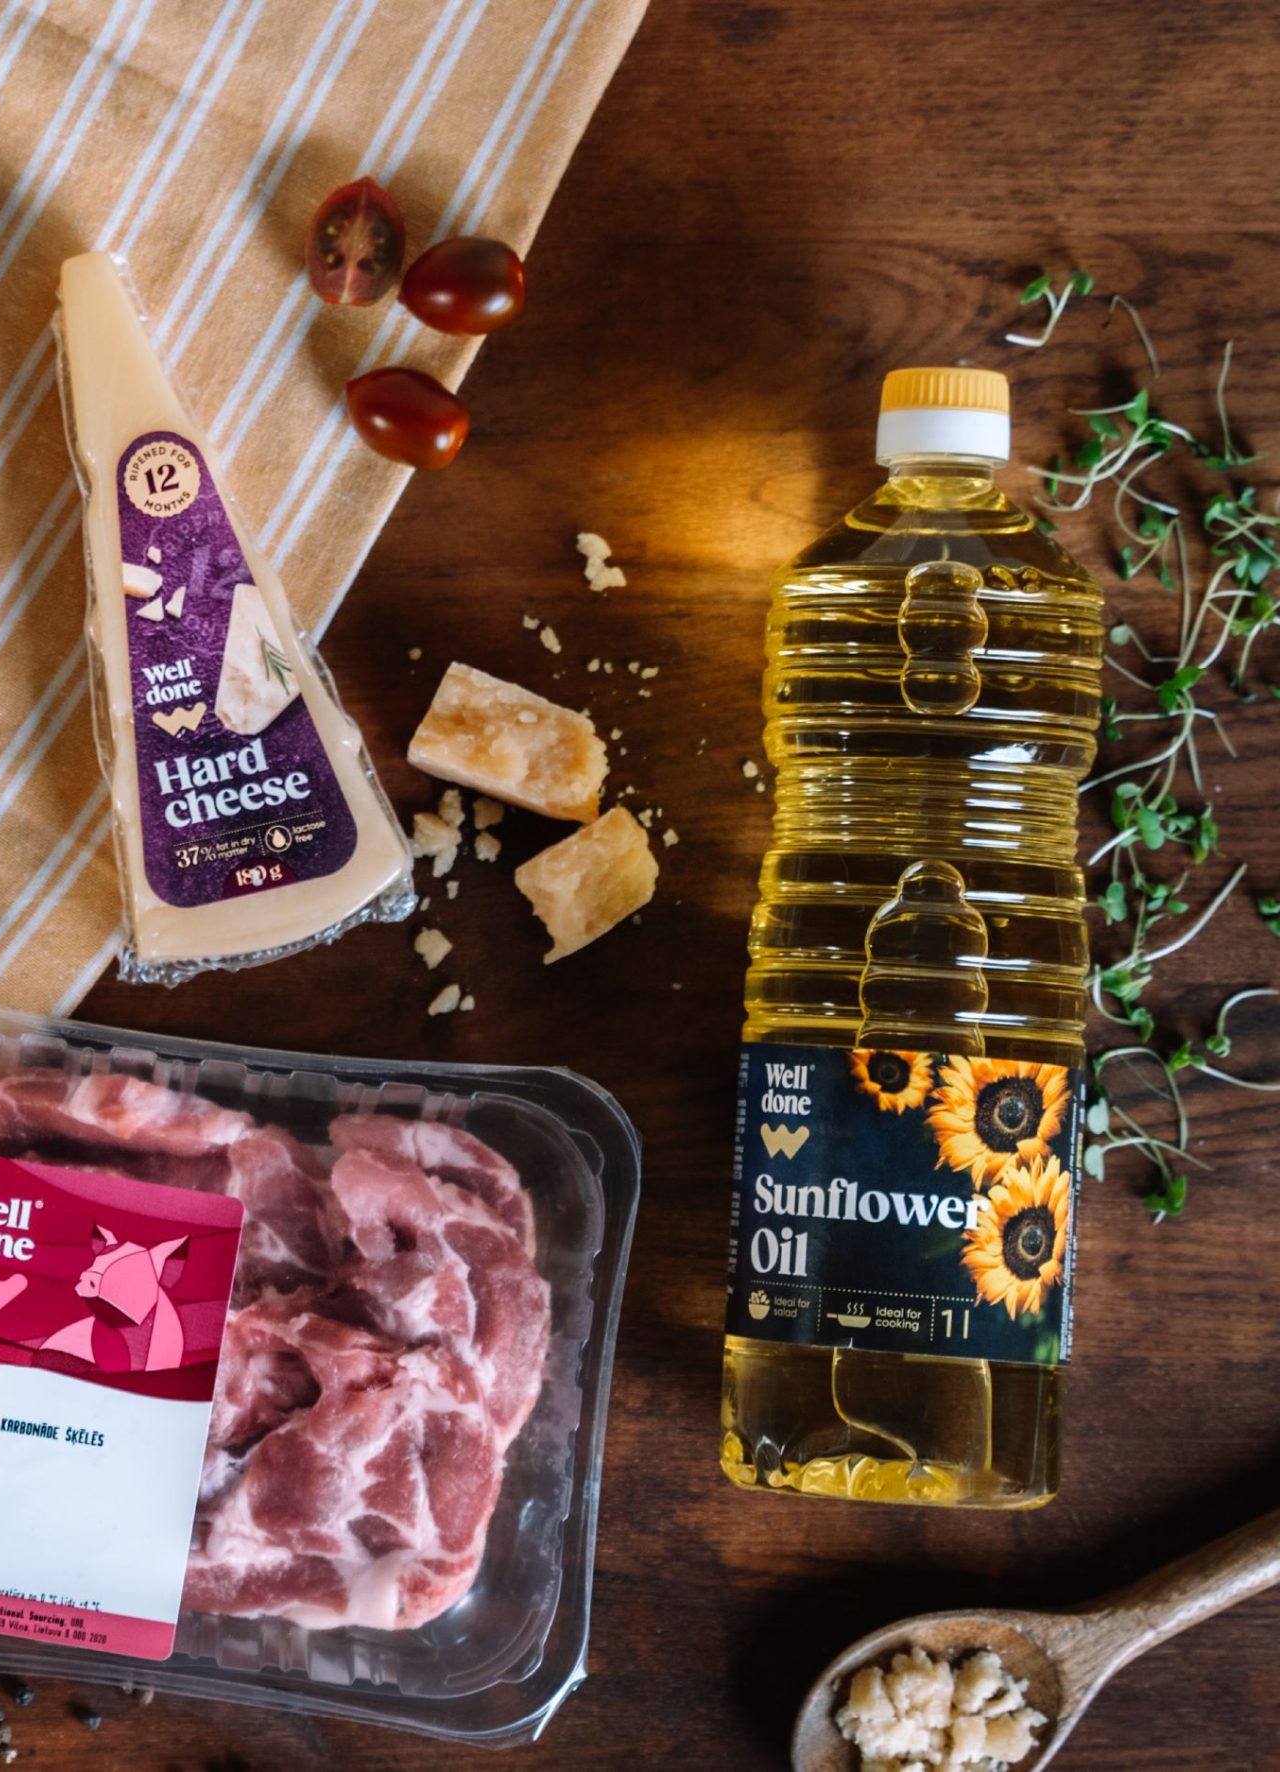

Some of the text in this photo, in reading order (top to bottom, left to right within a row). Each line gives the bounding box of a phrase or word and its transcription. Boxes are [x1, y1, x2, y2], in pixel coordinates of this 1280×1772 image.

[129, 446, 191, 481] RIPENED FOR
[144, 464, 179, 495] 12
[144, 491, 191, 512] MONTHS
[142, 658, 194, 685] Well
[146, 679, 202, 705] done
[154, 738, 269, 795] Hard
[165, 771, 311, 828] cheese
[292, 820, 327, 833] lactose
[294, 833, 313, 844] free
[176, 836, 257, 868] 37% fat in dry
[217, 847, 249, 860] matter
[270, 864, 283, 880] g
[765, 1063, 808, 1090] Well
[761, 1088, 812, 1115] done
[753, 1173, 989, 1231] Sunflower
[751, 1226, 808, 1277] Oil
[773, 1307, 798, 1318] salad
[774, 1295, 810, 1308] Ideal for
[876, 1306, 922, 1320] Ideal for
[875, 1319, 920, 1333] cooking
[941, 1309, 953, 1339] 1
[0, 1418, 60, 1440] KARBONĀDE
[65, 1426, 105, 1447] ŠĶĒLĒS
